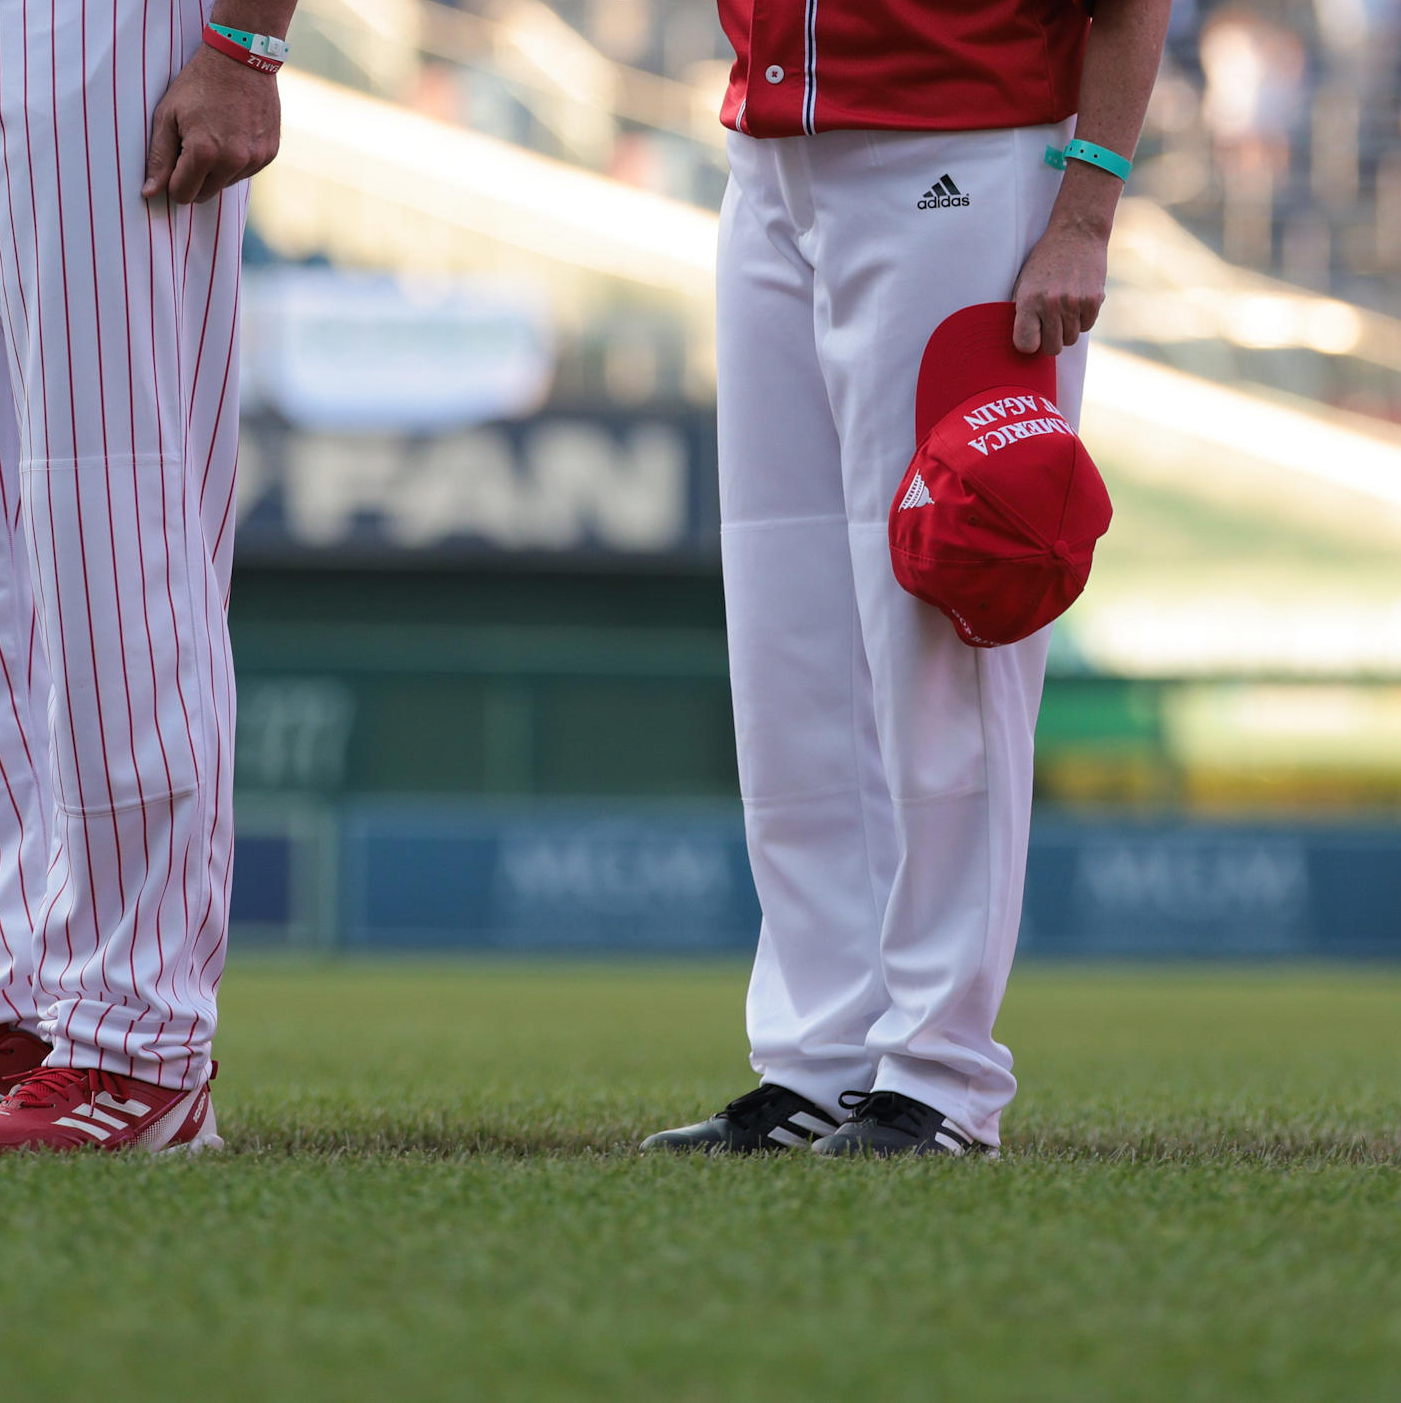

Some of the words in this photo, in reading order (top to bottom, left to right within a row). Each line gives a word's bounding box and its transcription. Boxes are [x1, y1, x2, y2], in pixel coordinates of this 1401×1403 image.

[917, 193, 971, 211] adidas
[963, 395, 1038, 431] AGAIN
[283, 423, 686, 551] FAN
